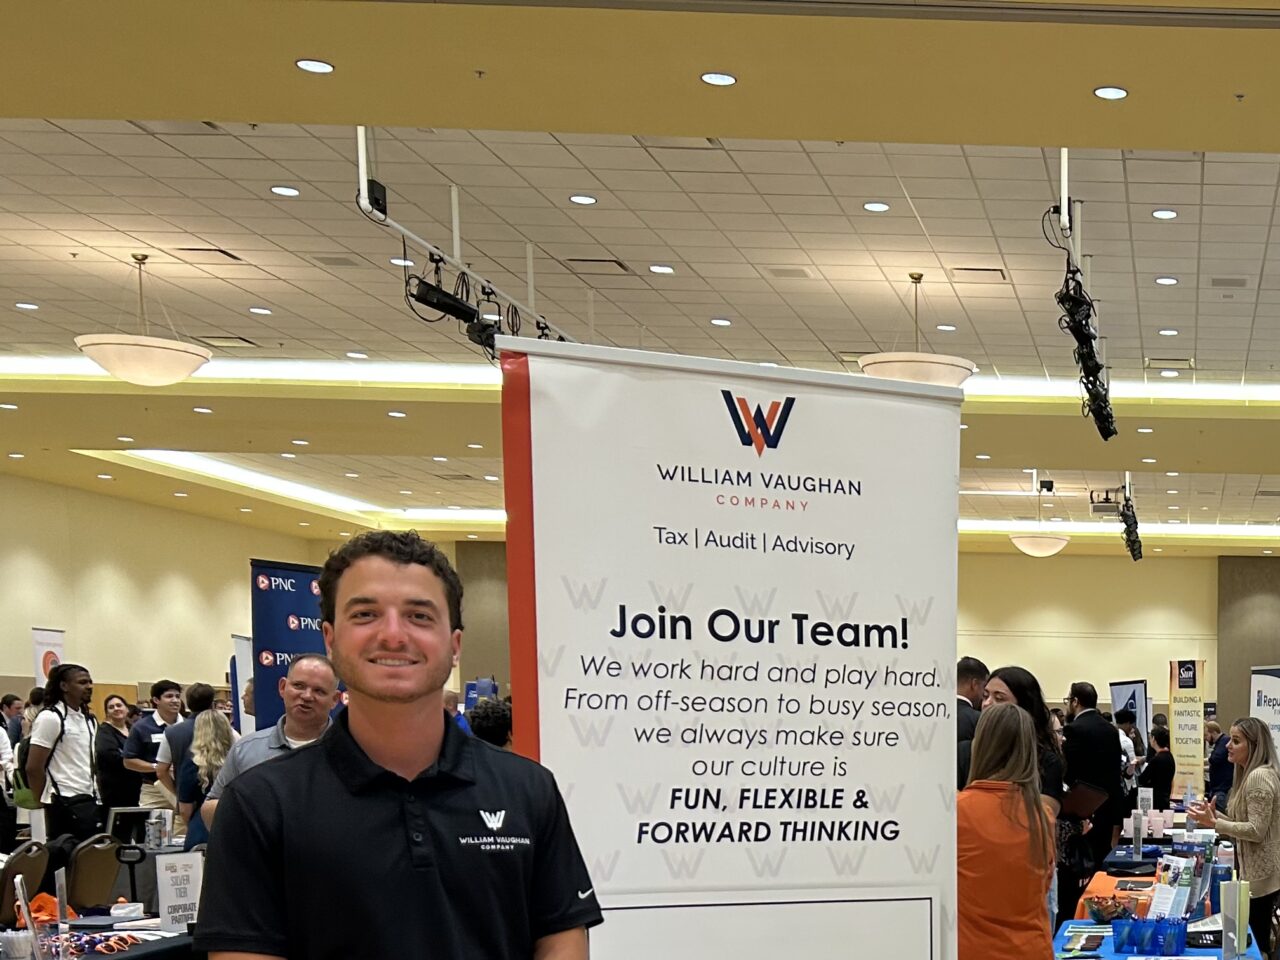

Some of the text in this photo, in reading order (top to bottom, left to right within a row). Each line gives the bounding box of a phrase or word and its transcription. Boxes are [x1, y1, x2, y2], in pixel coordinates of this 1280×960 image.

[656, 463, 862, 496] WILLIAM VAUGHAN
[716, 494, 809, 511] COMPANY
[653, 526, 689, 546] Tax
[704, 530, 757, 550] Audit
[772, 535, 855, 560] Advisory
[270, 576, 296, 592] PNC
[299, 616, 321, 631] PNC
[609, 604, 909, 650] Join Our Team!
[275, 652, 295, 666] PN
[580, 655, 941, 690] We work hard and play hard.
[564, 687, 951, 720] From off-season to busy season,
[1173, 696, 1198, 704] BUILDING
[633, 723, 899, 749] we always make sure
[692, 756, 848, 777] our culture is
[669, 787, 870, 812] FUN, FLEXIBLE &
[459, 836, 531, 845] WILLIAM VAUGHAN
[637, 820, 900, 844] FORWARD THINKING
[167, 902, 197, 915] CORPORATE
